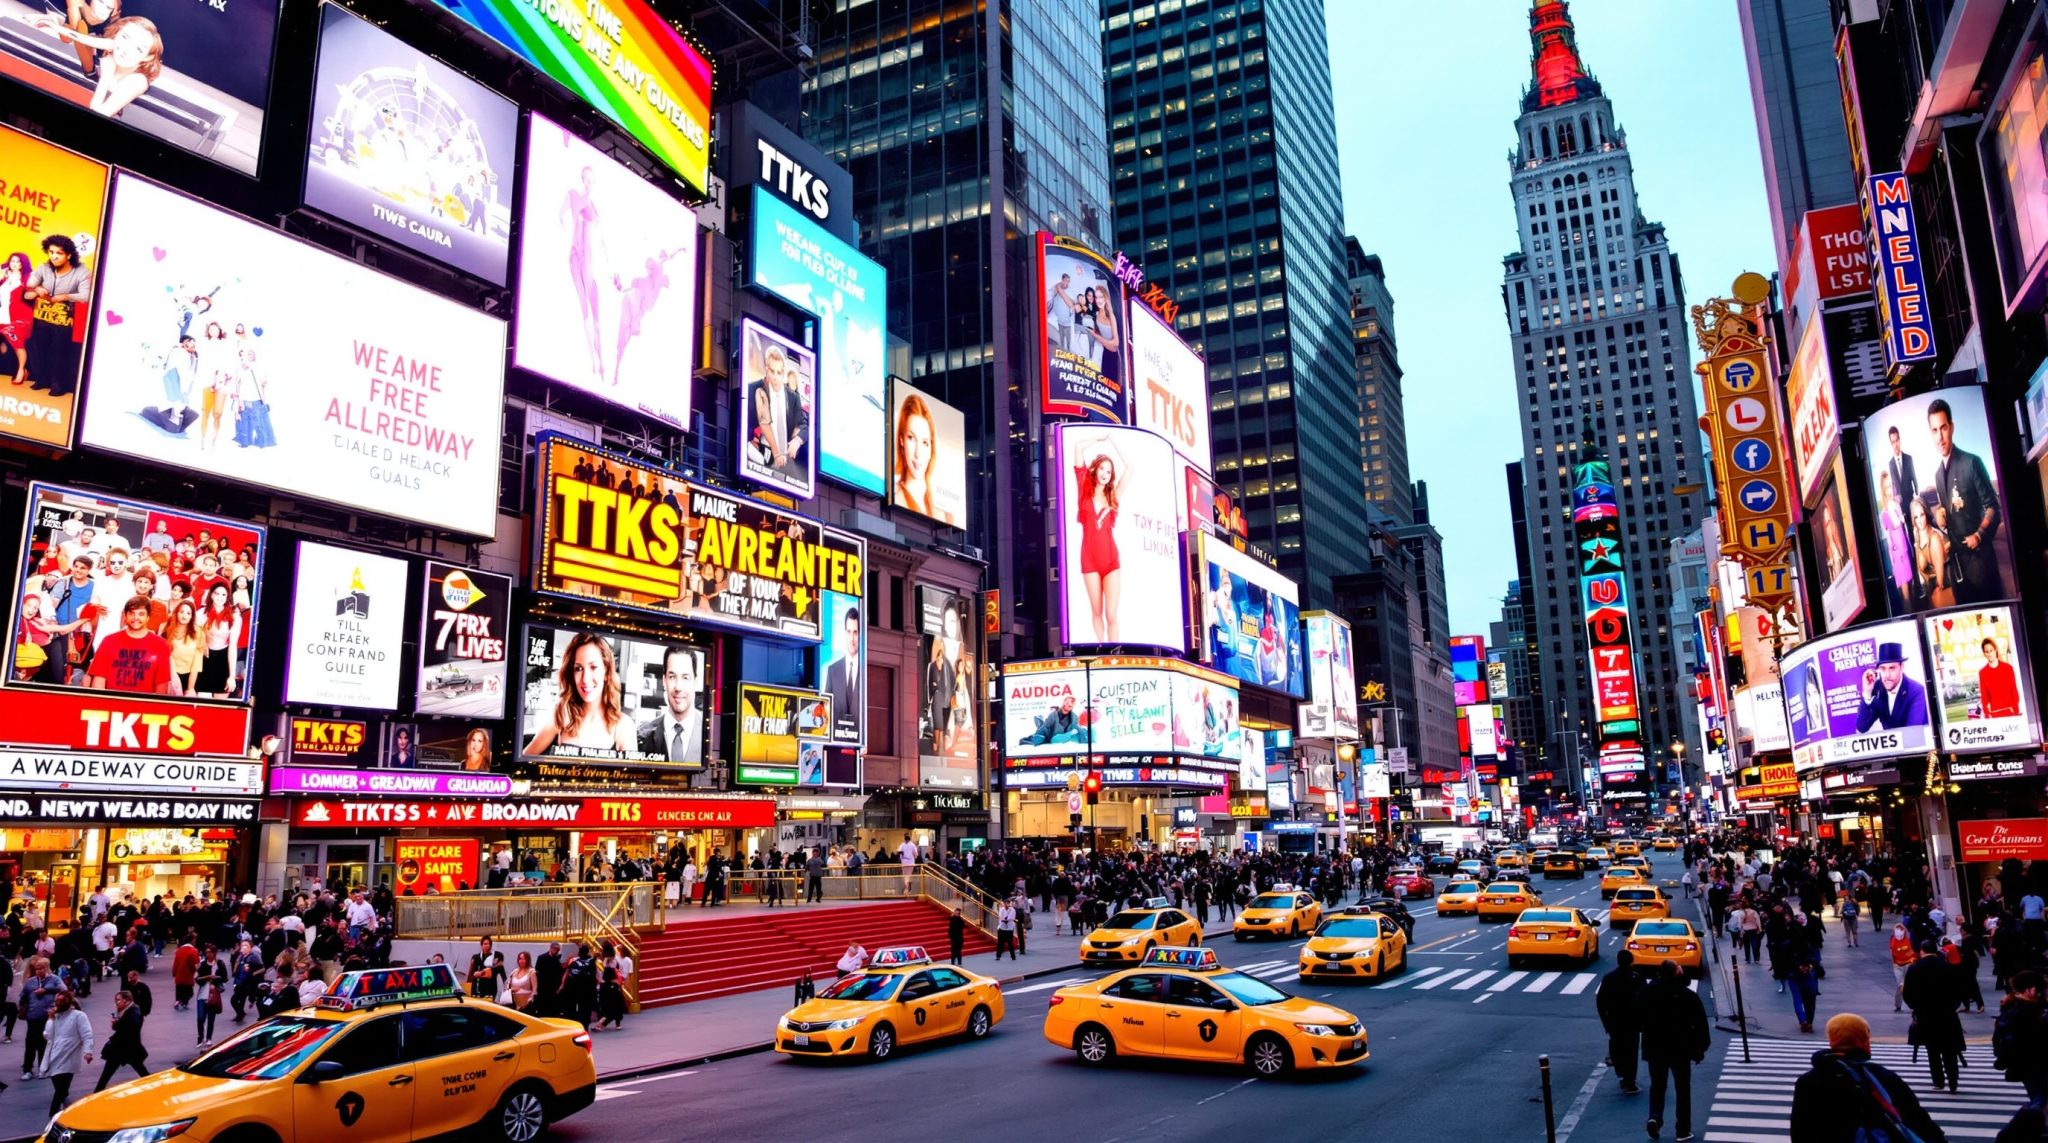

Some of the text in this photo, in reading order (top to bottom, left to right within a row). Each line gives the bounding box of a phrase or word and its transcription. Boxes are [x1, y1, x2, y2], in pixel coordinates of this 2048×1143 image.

[757, 138, 829, 219] TTKS
[9, 184, 61, 212] AMEY
[372, 203, 452, 249] TIWS CAURA
[1876, 178, 1930, 356] MNELED
[370, 378, 428, 419] FREE
[1146, 376, 1197, 448] TTKS
[1734, 404, 1758, 424] L
[325, 397, 474, 461] ALLREDWAY
[370, 466, 421, 491] GUALS
[555, 476, 681, 566] TTKS
[1749, 523, 1776, 547] H
[433, 610, 457, 651] 7
[457, 635, 503, 661] LIVES
[325, 661, 366, 676] GUILE
[80, 709, 195, 750] TKTS
[293, 720, 362, 744] TKTS
[1852, 735, 1898, 753] CTIVES
[11, 757, 26, 775] A
[35, 759, 146, 779] WADEWAY
[153, 764, 237, 782] COURIDE
[41, 801, 99, 818] NEWT
[103, 802, 170, 818] WEARS
[173, 804, 220, 819] BOAY
[222, 805, 253, 819] INC
[482, 803, 580, 821] BROADWAY
[601, 802, 641, 821] TTKS
[429, 846, 461, 858] CARE
[425, 862, 463, 875] SANTS
